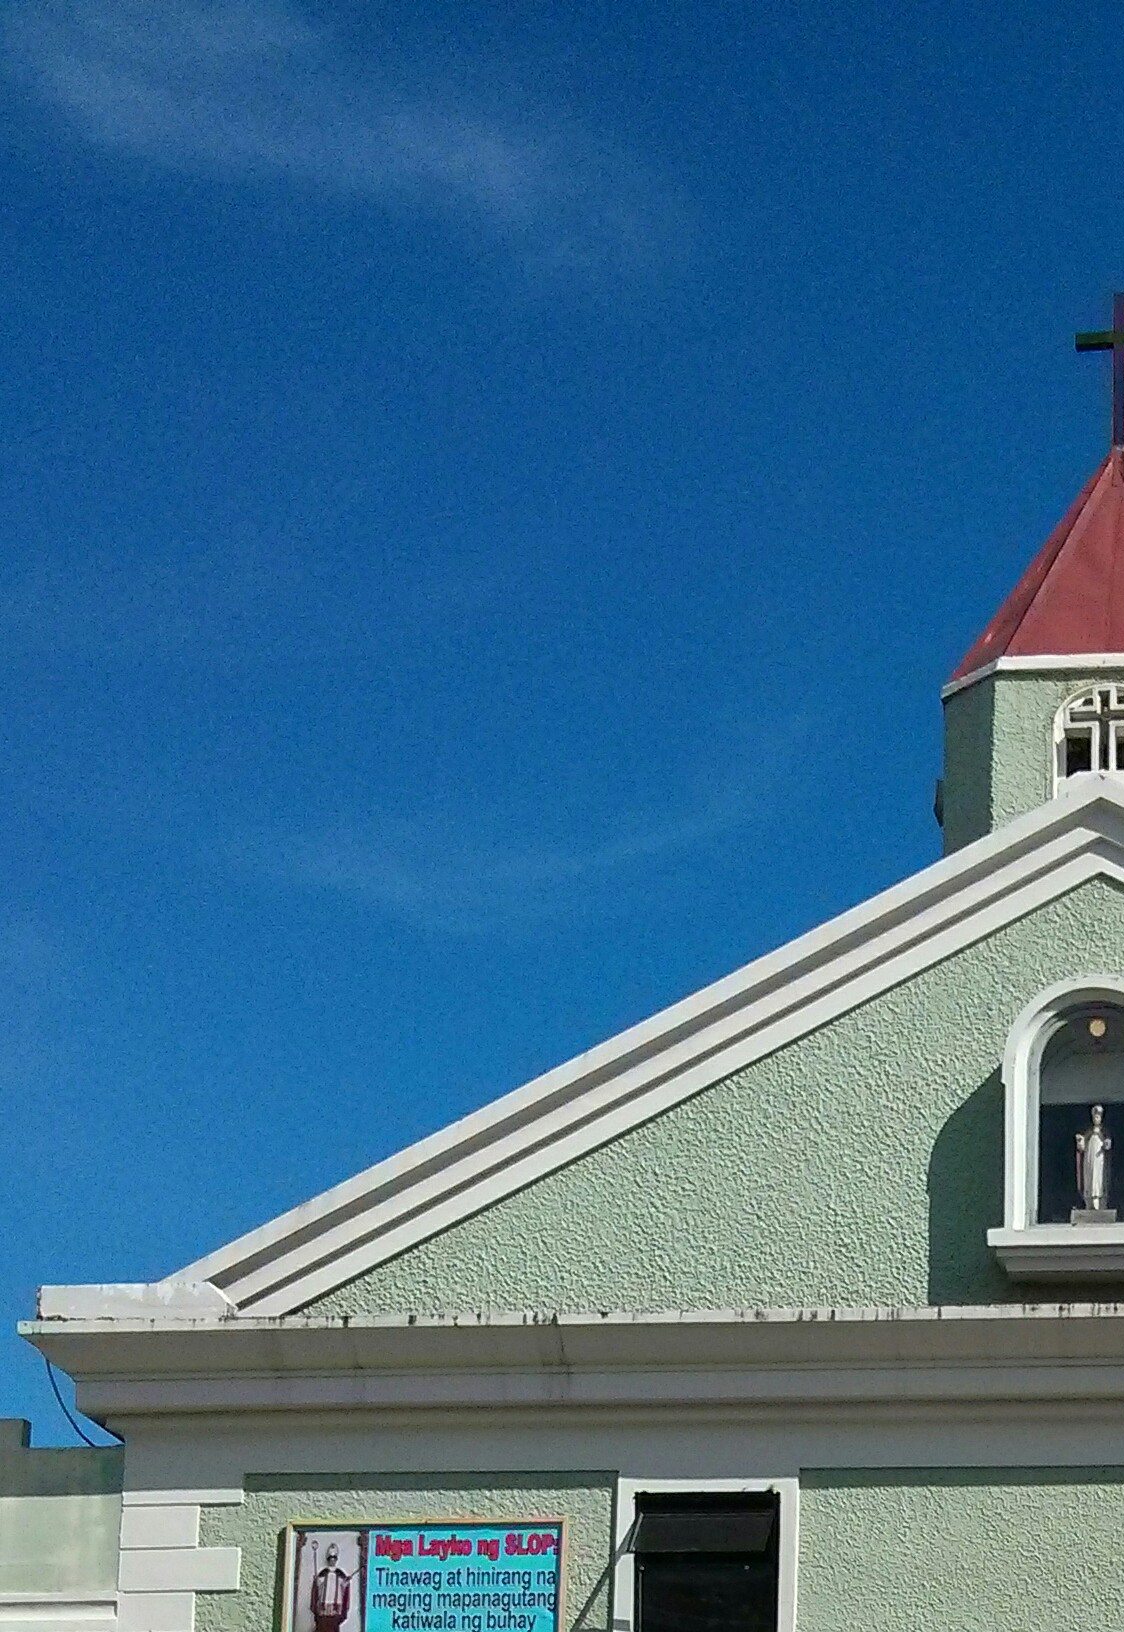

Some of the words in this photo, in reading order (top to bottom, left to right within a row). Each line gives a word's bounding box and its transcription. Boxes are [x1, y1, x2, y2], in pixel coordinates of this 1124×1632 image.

[375, 1534, 413, 1561] Mga
[418, 1534, 472, 1561] Layko
[477, 1539, 500, 1561] ng
[375, 1567, 442, 1591] Tinawag
[446, 1568, 462, 1587] at
[466, 1566, 532, 1590] hinirang
[537, 1570, 556, 1585] na
[372, 1589, 432, 1612] maging
[437, 1589, 556, 1612] mapanagutang
[392, 1610, 456, 1630] katiwala
[486, 1610, 537, 1632] buhay
